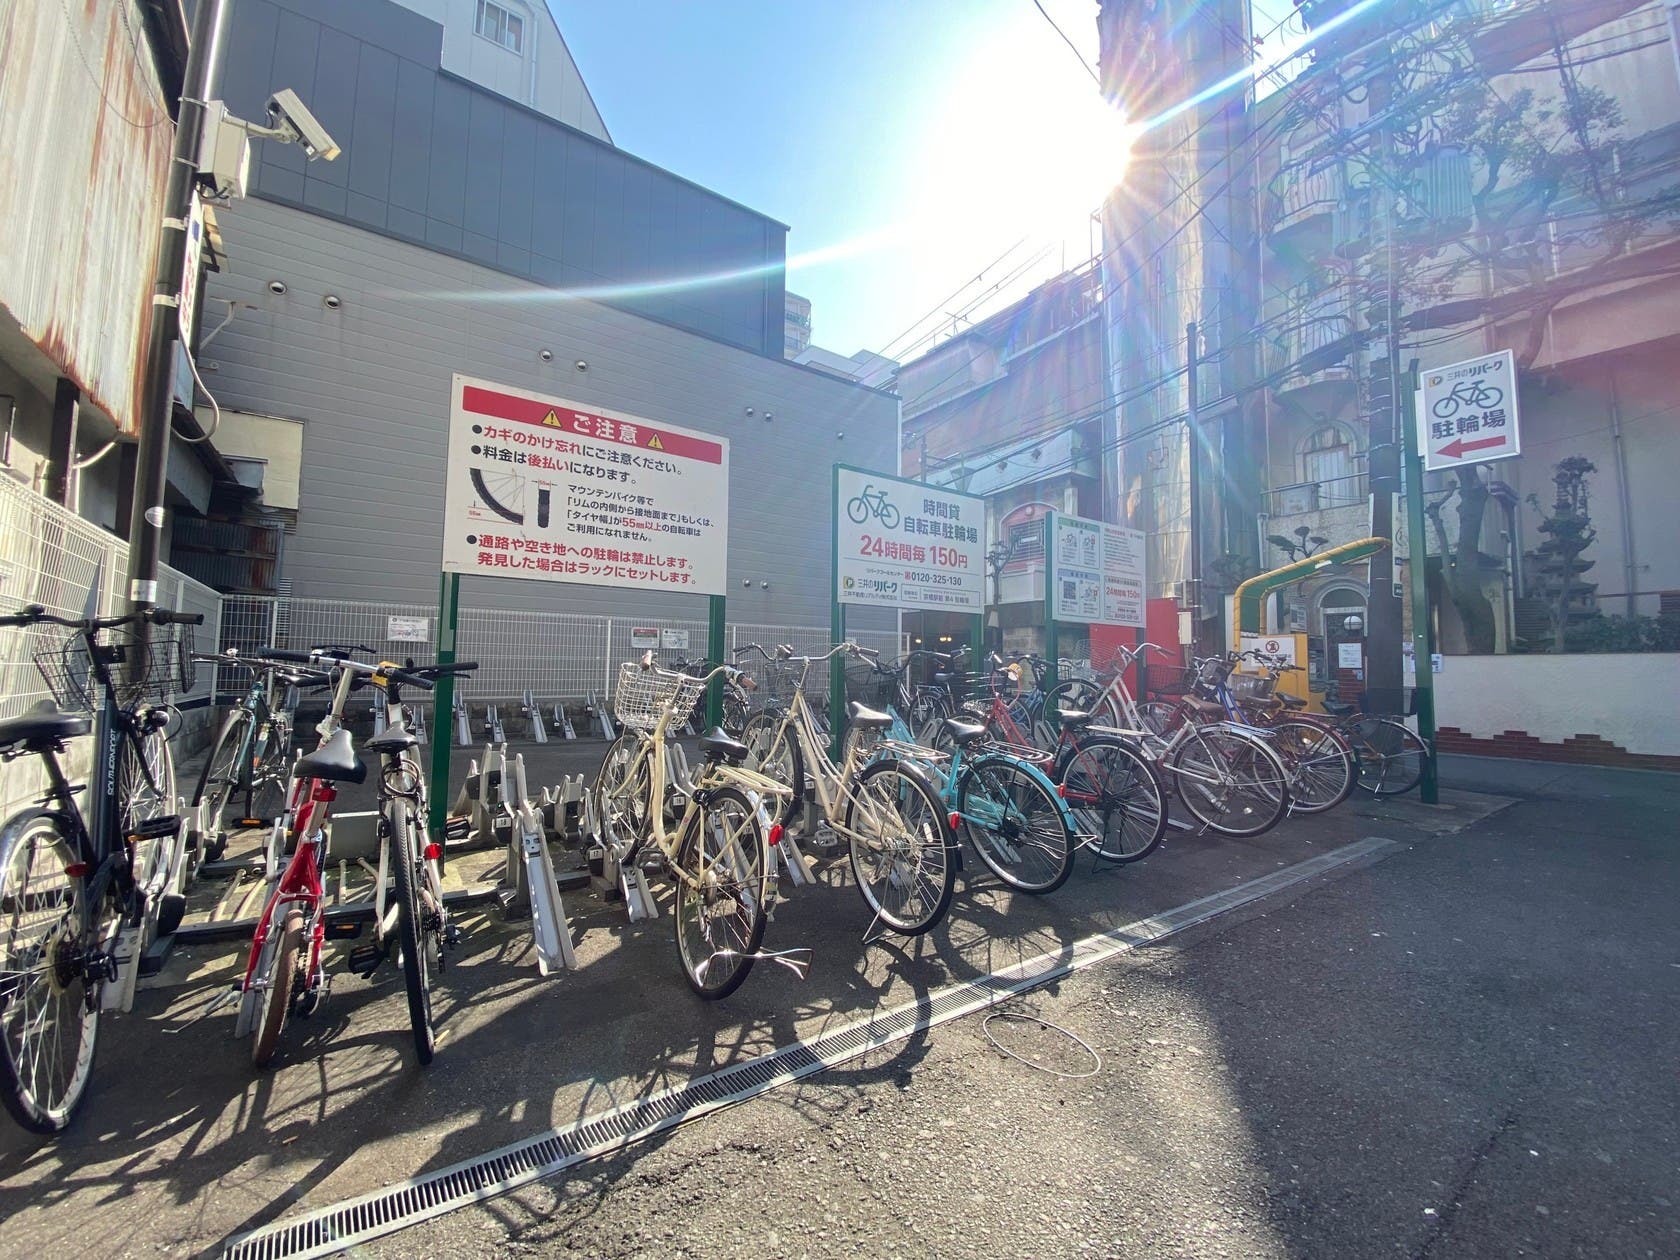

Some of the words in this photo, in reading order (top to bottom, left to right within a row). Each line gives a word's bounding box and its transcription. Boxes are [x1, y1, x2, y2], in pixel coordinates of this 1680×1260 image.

[573, 413, 637, 444] ご注意
[1431, 409, 1506, 439] 駐輪場
[482, 445, 637, 484] 料金は後払いになります。
[483, 425, 682, 475] カギのかけ忘れにご注意ください。
[568, 484, 654, 506] マウンテンバイク等で
[923, 499, 960, 520] 時間貸
[567, 523, 652, 542] ご利用になれません。
[904, 516, 978, 544] 自転車駐輪場
[479, 534, 693, 569] 通路や空き地への駐輪は禁止します。
[860, 534, 926, 564] 24時間毎
[929, 545, 968, 568] 150円
[477, 551, 696, 585] 発見した場合はラックにセットします。
